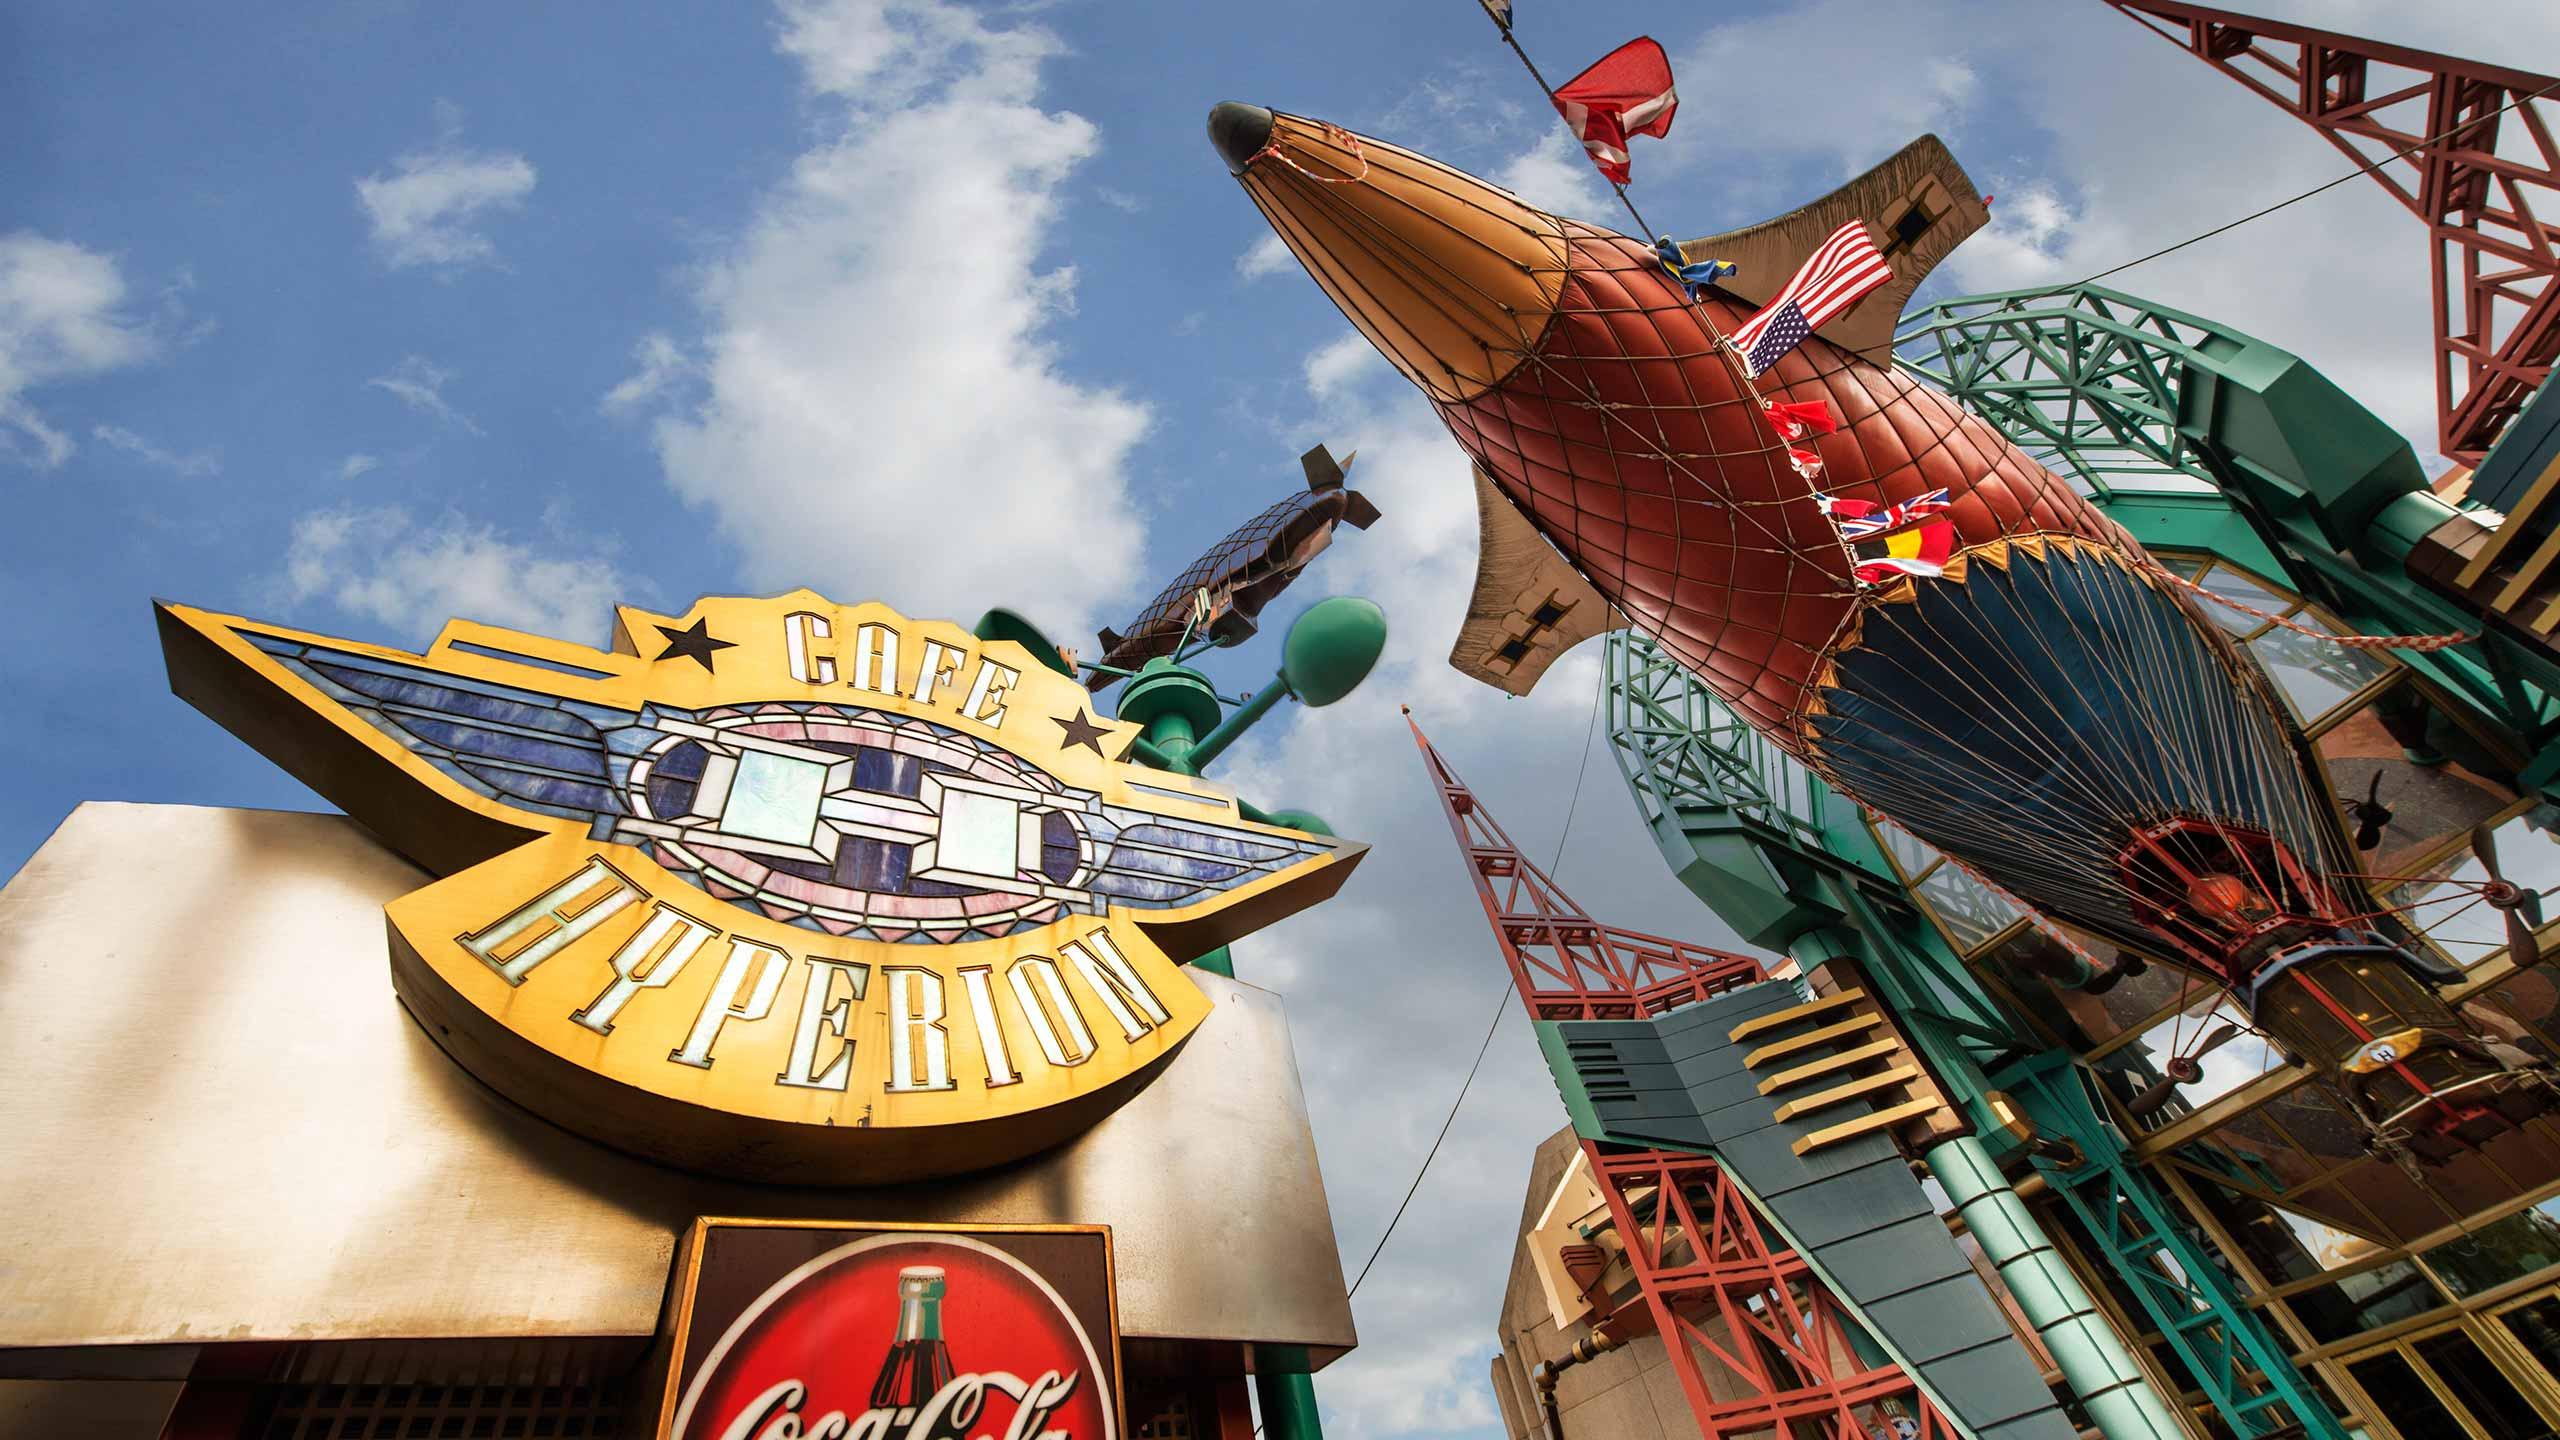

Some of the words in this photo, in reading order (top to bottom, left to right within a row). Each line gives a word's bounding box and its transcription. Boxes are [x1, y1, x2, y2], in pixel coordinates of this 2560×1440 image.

[784, 610, 1021, 729] CAFE
[453, 853, 1172, 1094] HYPERION
[719, 1368, 1078, 1440] Coca-Cl
